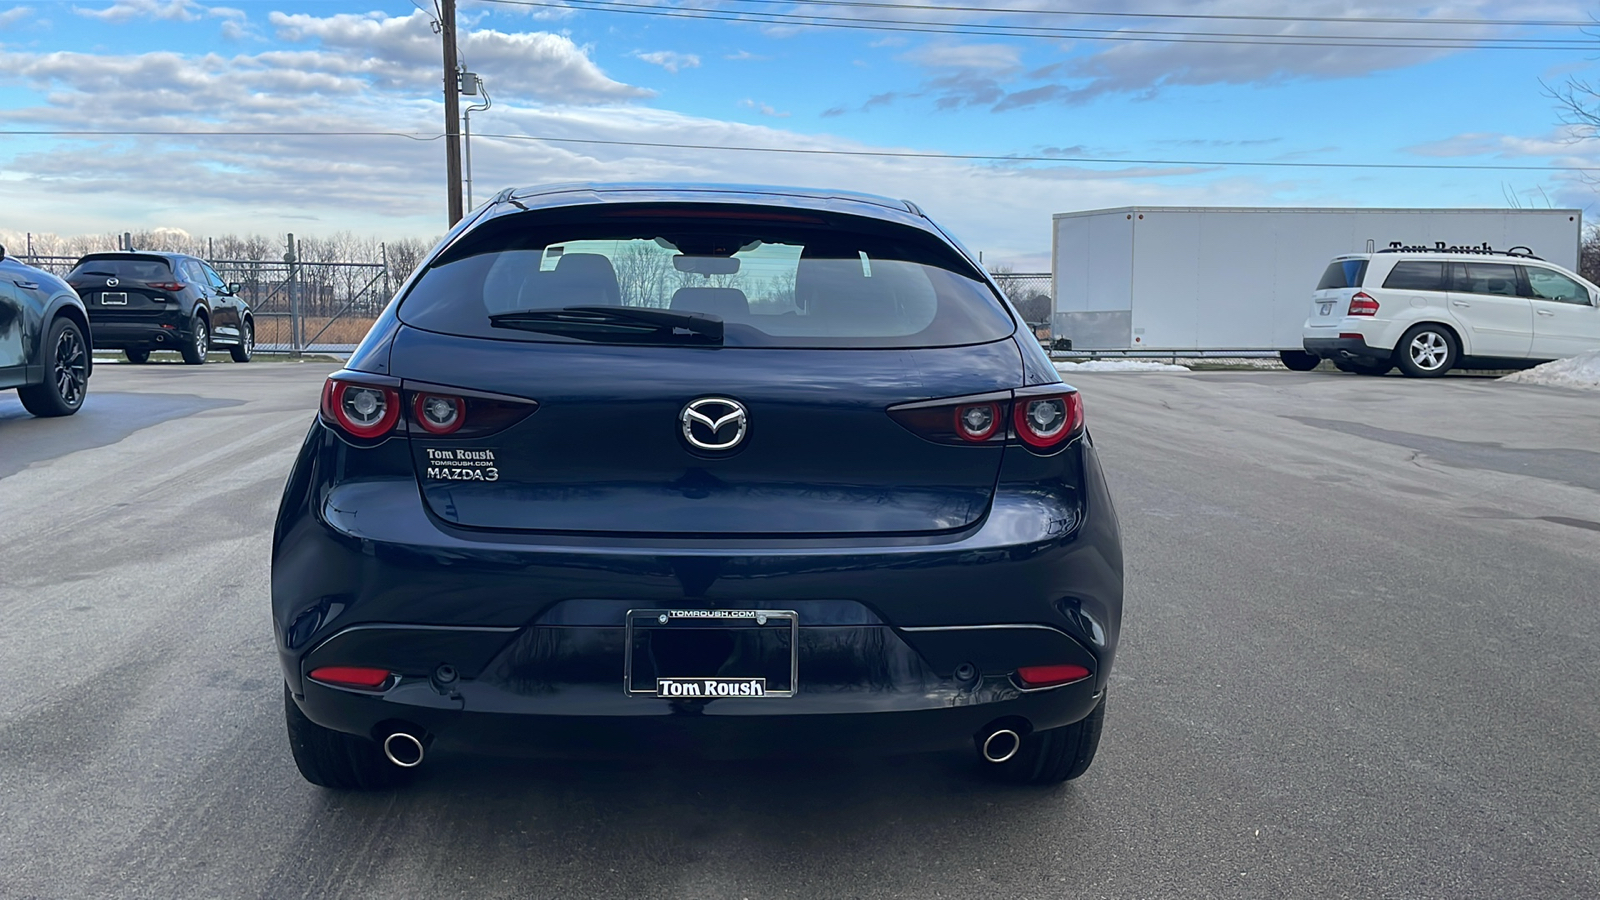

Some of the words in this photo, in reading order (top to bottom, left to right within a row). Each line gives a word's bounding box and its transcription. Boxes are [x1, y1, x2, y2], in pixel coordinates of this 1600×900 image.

[1389, 241, 1428, 253] Tom
[426, 448, 454, 460] Tom
[456, 449, 495, 460] Roush
[670, 610, 755, 618] TOMROUSH.COM
[659, 680, 701, 696] Tom
[704, 679, 763, 696] Roush
